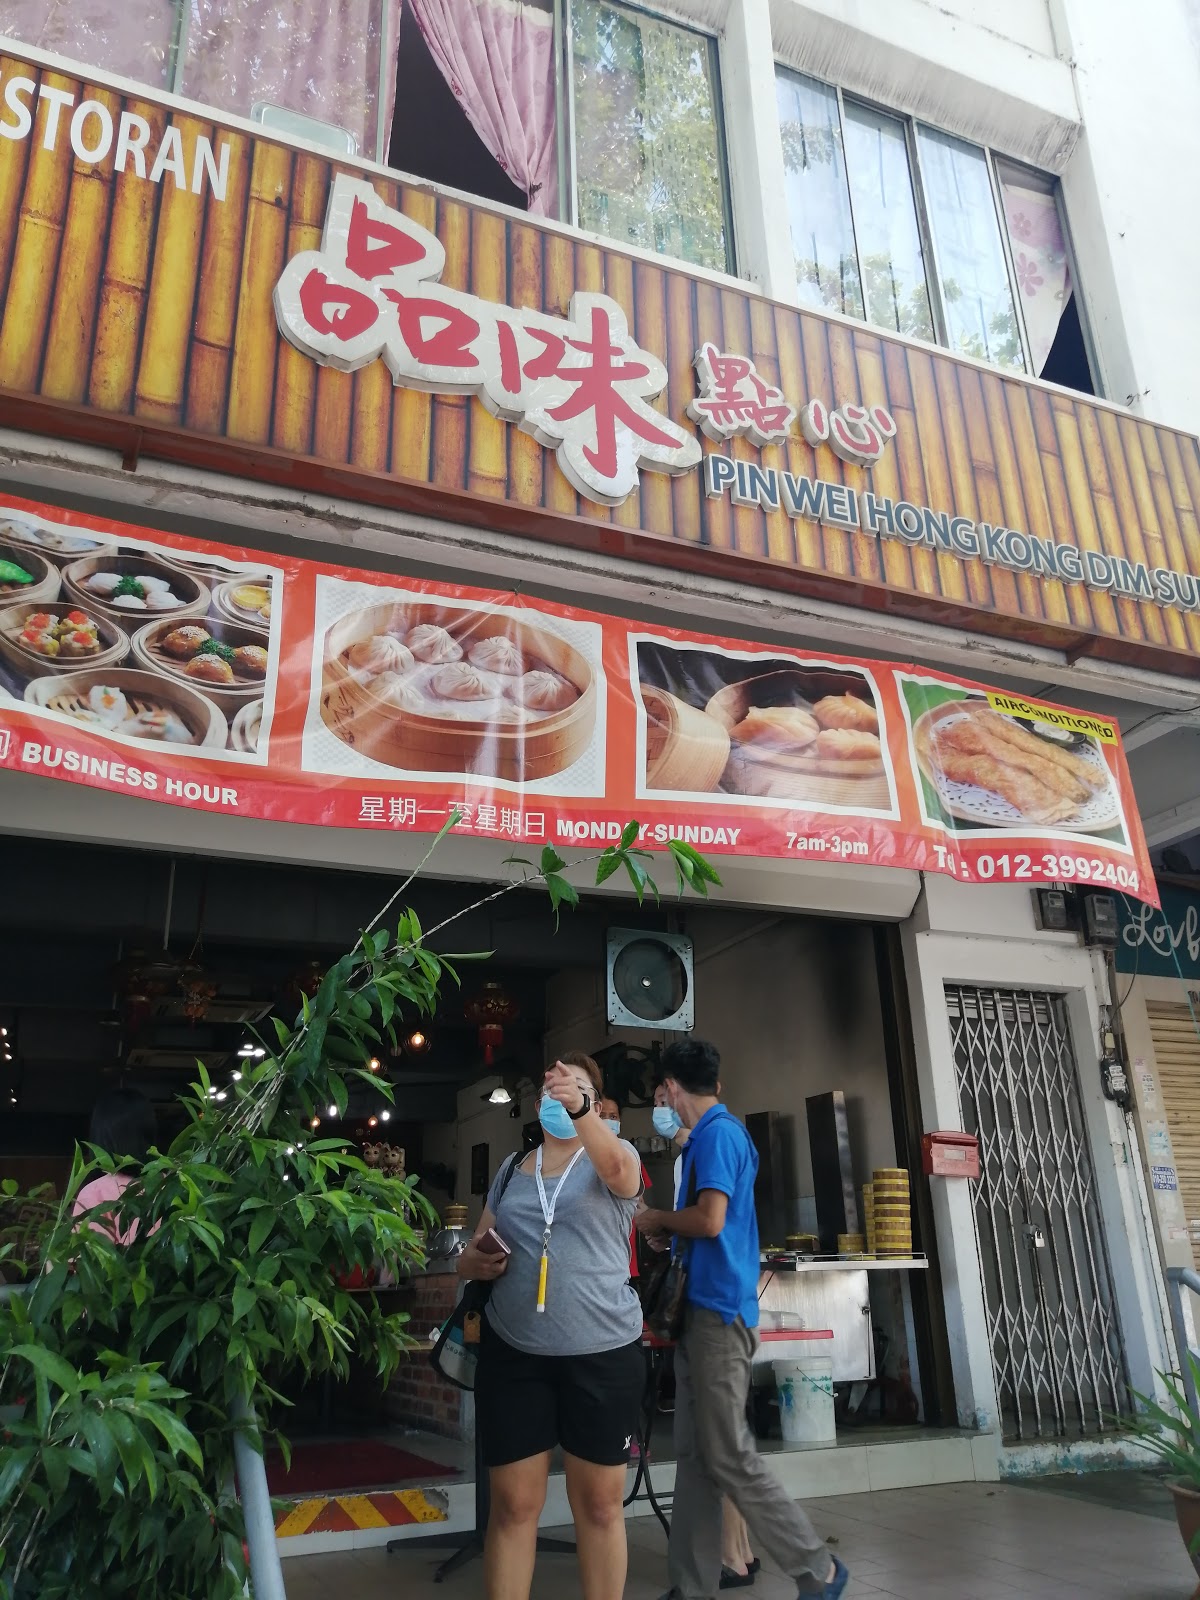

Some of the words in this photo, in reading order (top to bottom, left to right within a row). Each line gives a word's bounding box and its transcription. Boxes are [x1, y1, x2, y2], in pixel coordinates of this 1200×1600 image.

[0, 71, 231, 203] STORAN
[297, 194, 685, 480] 品味
[707, 453, 780, 510] PIN
[782, 471, 860, 530] WEI
[862, 492, 979, 557] HONG
[980, 521, 1084, 583] KONG
[1083, 549, 1154, 601] DIM
[1153, 568, 1200, 612] SU
[994, 696, 1114, 739] AIRCONDITIONED
[22, 741, 158, 790] BUSINESS
[165, 777, 239, 806] HOUR
[357, 796, 546, 838] 星期一至星期日
[556, 819, 741, 846] MONDY-SUNDAY
[786, 832, 869, 858] 7am-3pm
[977, 854, 1140, 892] 012-3992404
